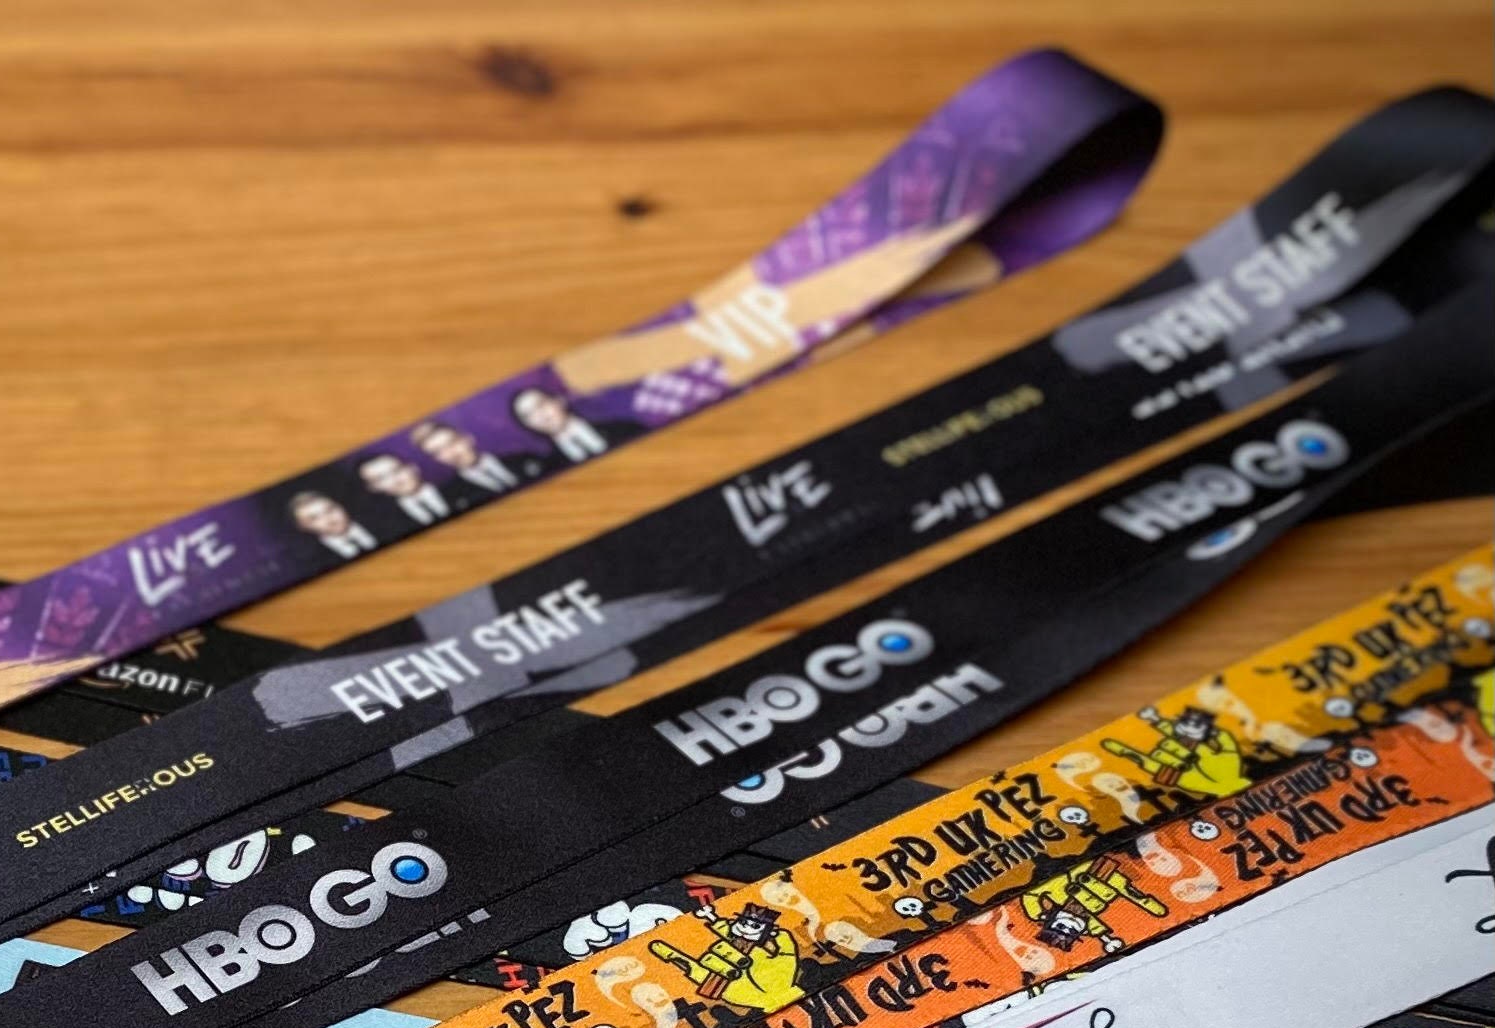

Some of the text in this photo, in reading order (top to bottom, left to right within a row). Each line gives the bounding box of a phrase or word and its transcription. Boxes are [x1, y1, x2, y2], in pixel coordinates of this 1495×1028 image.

[683, 282, 801, 362] VIP
[1115, 278, 1250, 374] EVENT
[1232, 190, 1364, 308] STAFF
[1099, 464, 1255, 542] HBO
[1232, 418, 1352, 488] GO
[330, 578, 609, 725] EVENT STAFF
[652, 619, 937, 767] HBO GO
[852, 773, 1058, 894] 3RD UK PEZ
[922, 816, 1065, 904] GATHERING
[1220, 774, 1420, 883] PEZ UK 3RD
[130, 903, 318, 1017] HBO
[308, 840, 449, 930] GO
[866, 954, 960, 1013] 3RD
